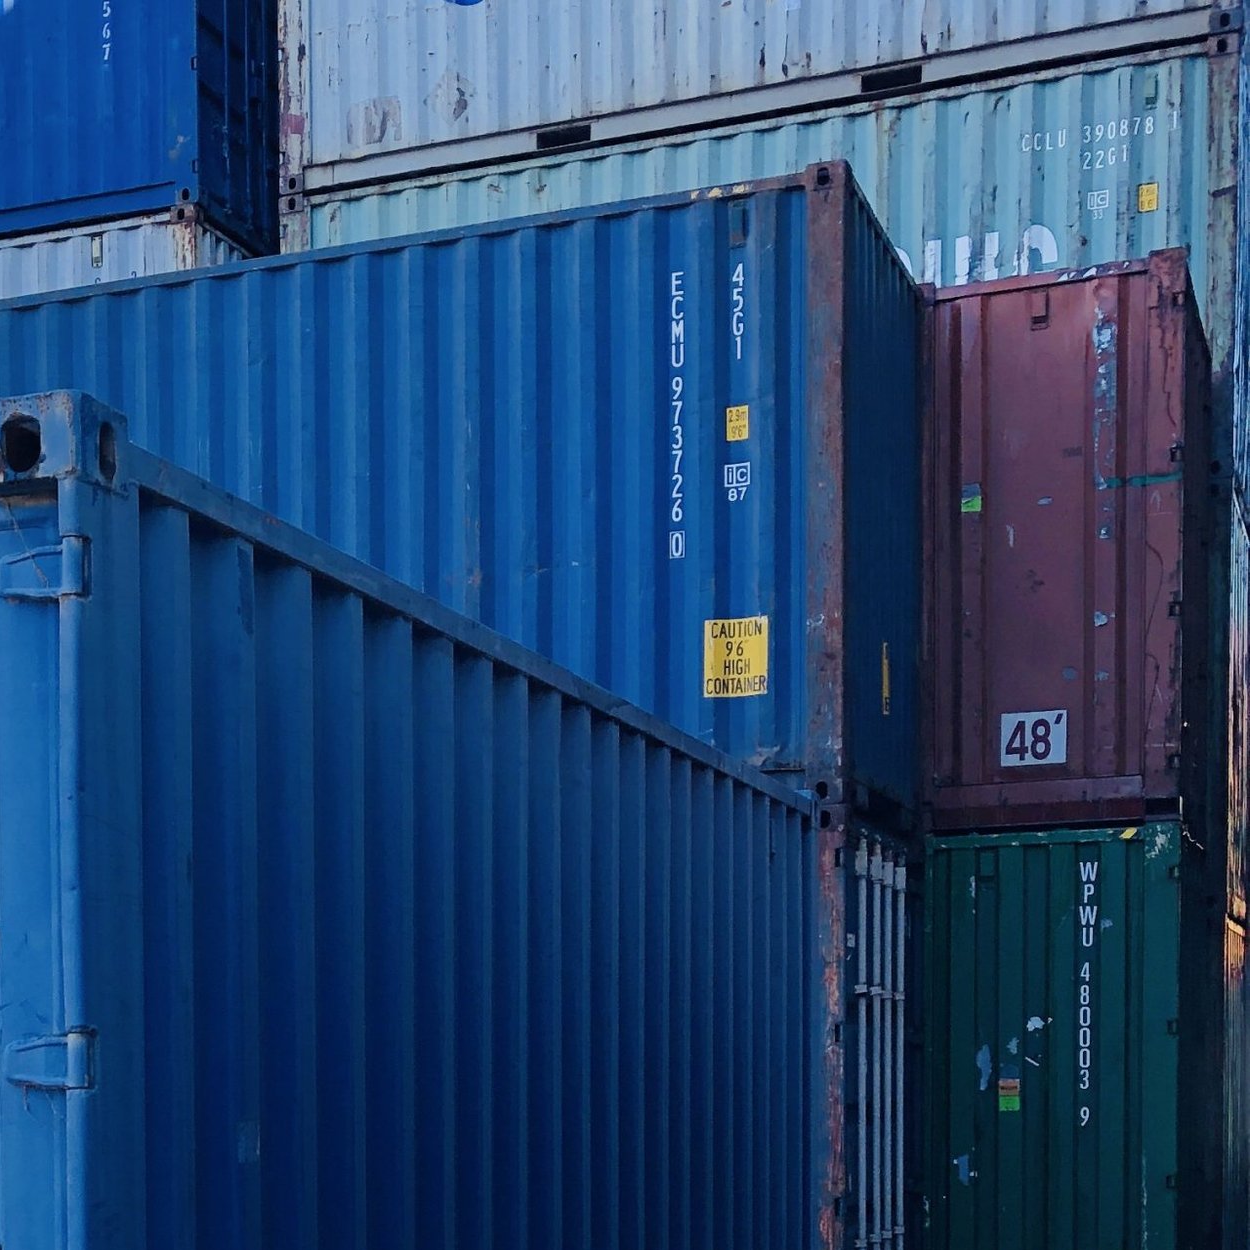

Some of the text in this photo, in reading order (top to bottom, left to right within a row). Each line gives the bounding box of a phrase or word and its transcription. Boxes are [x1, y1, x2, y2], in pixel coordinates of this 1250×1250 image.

[1022, 128, 1066, 152] CCLU
[1082, 116, 1154, 144] 390878
[1082, 145, 1127, 170] 22G1
[732, 262, 744, 360] 45G1
[671, 272, 684, 558] ECMU 973726 0
[728, 487, 747, 502] 87
[711, 619, 762, 639] CAUTION
[723, 658, 751, 676] HIGH
[706, 675, 766, 695] CONTAINER
[1005, 713, 1063, 761] 48'
[1079, 861, 1098, 1127] WPWU 480003 9
